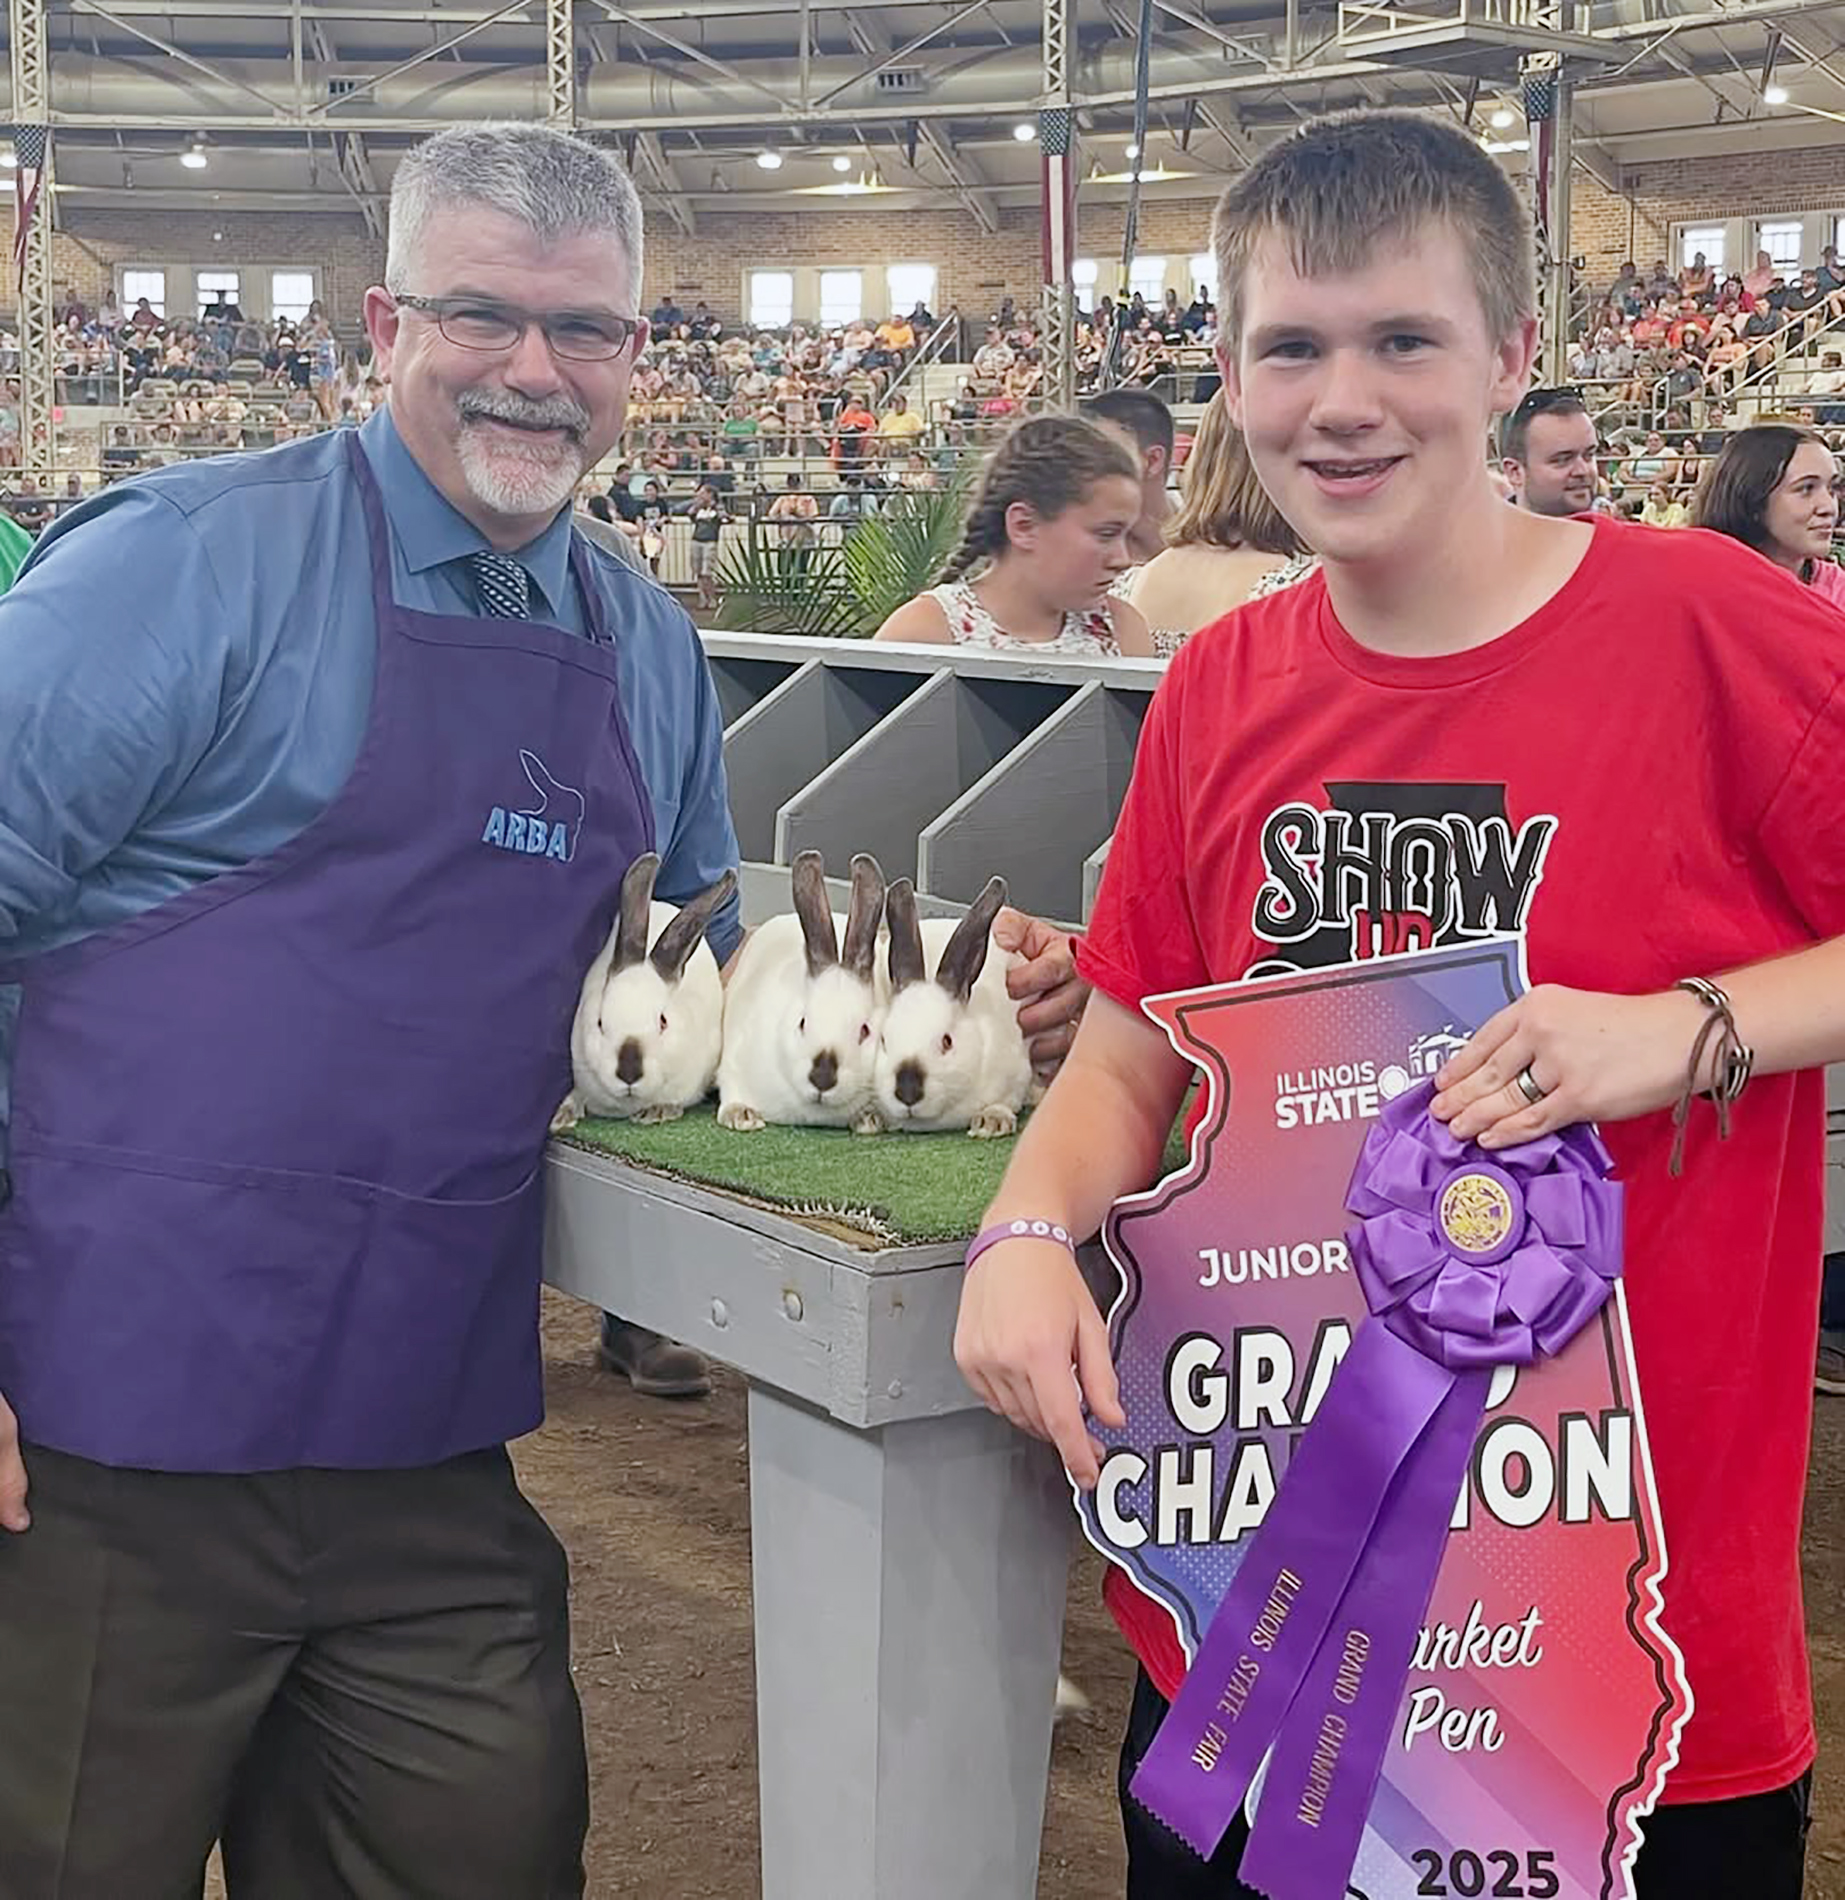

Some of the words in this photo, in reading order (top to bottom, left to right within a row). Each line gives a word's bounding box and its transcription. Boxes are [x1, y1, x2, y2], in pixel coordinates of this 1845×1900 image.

[482, 806, 567, 861] ARBA
[1253, 803, 1558, 943] SHOW
[1275, 1083, 1381, 1129] STATE
[1276, 1060, 1376, 1096] ILLINOIS
[1199, 1240, 1349, 1287] JUNIOR
[1165, 1319, 1518, 1435] GRA
[1096, 1413, 1633, 1549] CHAON
[1249, 1568, 1303, 1652] ILLINOIS
[1216, 1654, 1260, 1722] STATE
[1332, 1629, 1371, 1705] GRAND
[1190, 1721, 1228, 1772] FAIR
[1403, 1685, 1506, 1753] Pen
[1297, 1713, 1348, 1828] CHAMPION
[1411, 1848, 1560, 1899] 2025
